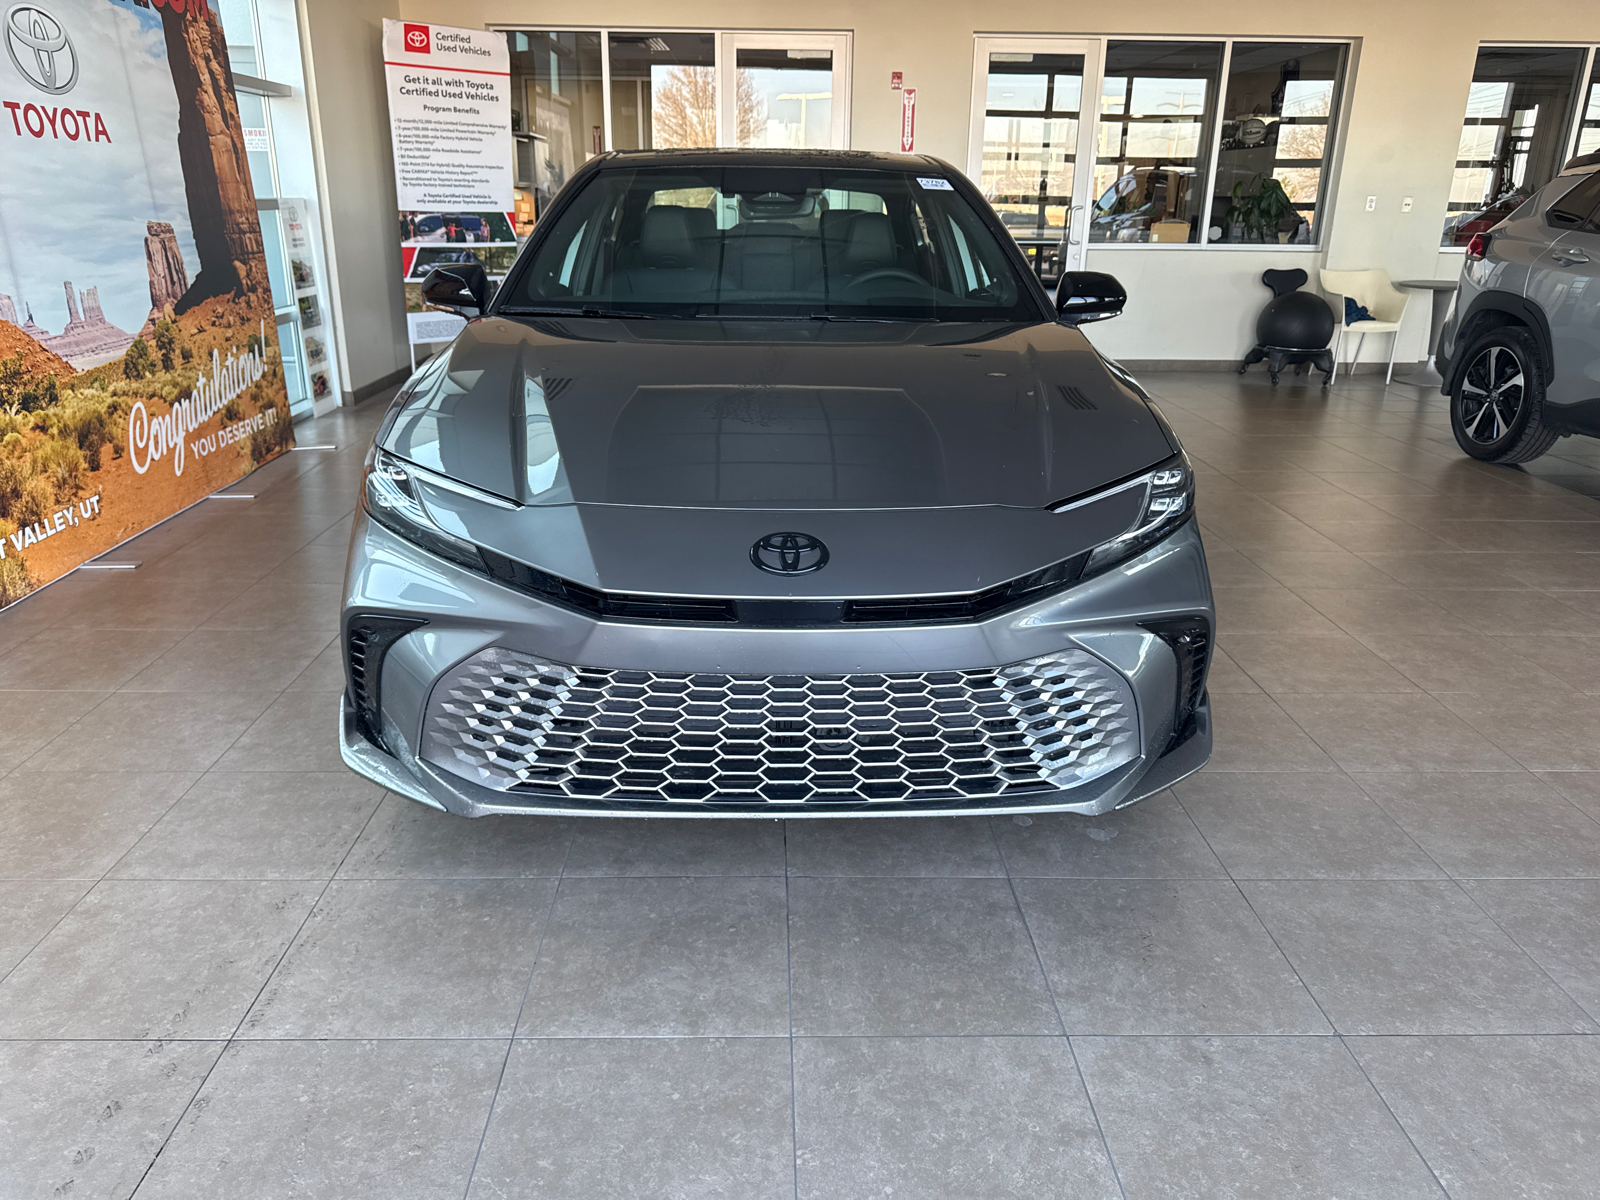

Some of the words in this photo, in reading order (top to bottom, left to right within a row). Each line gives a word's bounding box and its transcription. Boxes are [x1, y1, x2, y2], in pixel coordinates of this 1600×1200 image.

[436, 32, 470, 43] Certified
[436, 43, 457, 52] Used
[458, 45, 491, 56] Vehicles
[404, 75, 421, 85] Get
[423, 76, 429, 85] it
[431, 77, 442, 86] all
[444, 78, 464, 88] with
[466, 80, 494, 91] Toyota
[400, 87, 439, 97] Certified
[441, 90, 463, 99] Used
[464, 92, 499, 102] Vehicles
[423, 104, 452, 114] Program
[3, 100, 112, 143] TOYOTA
[129, 319, 268, 476] Congratulations!
[190, 436, 216, 459] YOU
[218, 414, 264, 448] DESERVE
[265, 407, 278, 426] IT!
[9, 506, 79, 552] VALLEY,
[79, 494, 99, 519] UT
